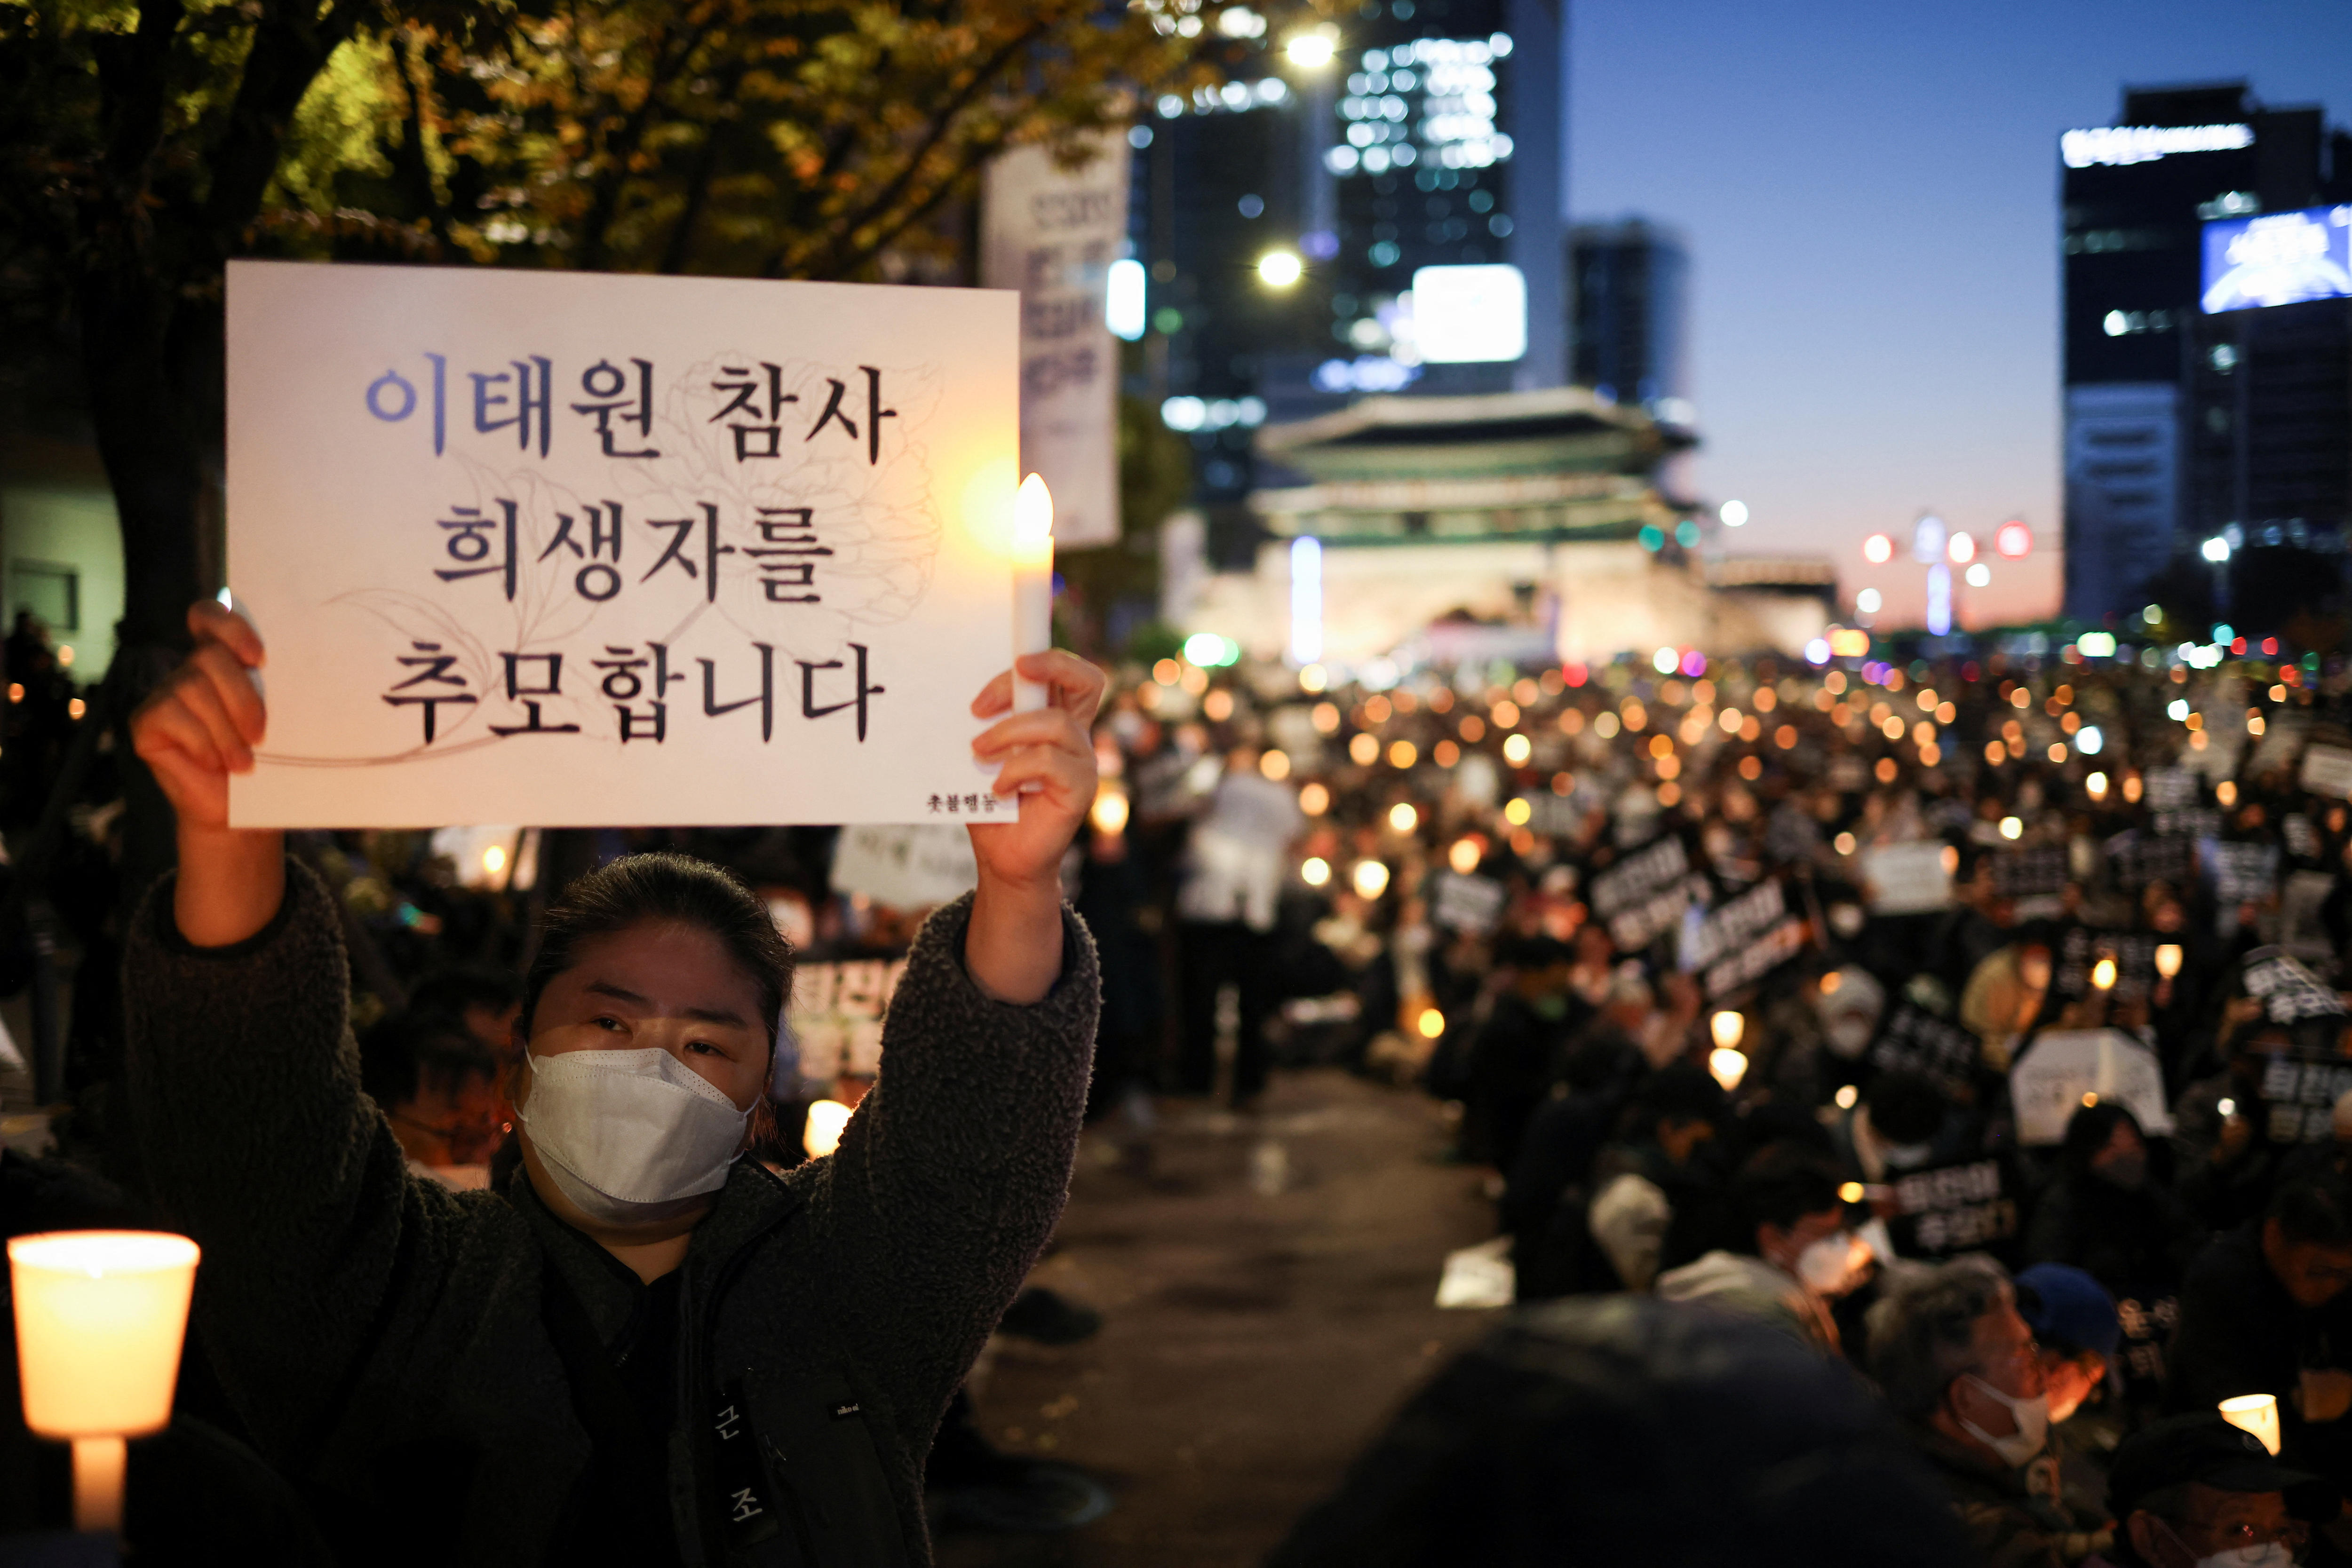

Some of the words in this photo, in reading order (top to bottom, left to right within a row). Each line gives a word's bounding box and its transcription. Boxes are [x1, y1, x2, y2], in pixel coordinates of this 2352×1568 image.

[366, 352, 661, 459] 이태원
[710, 362, 898, 466] 참사
[434, 499, 834, 603] 희생자를
[381, 641, 885, 745] 추모합니다
